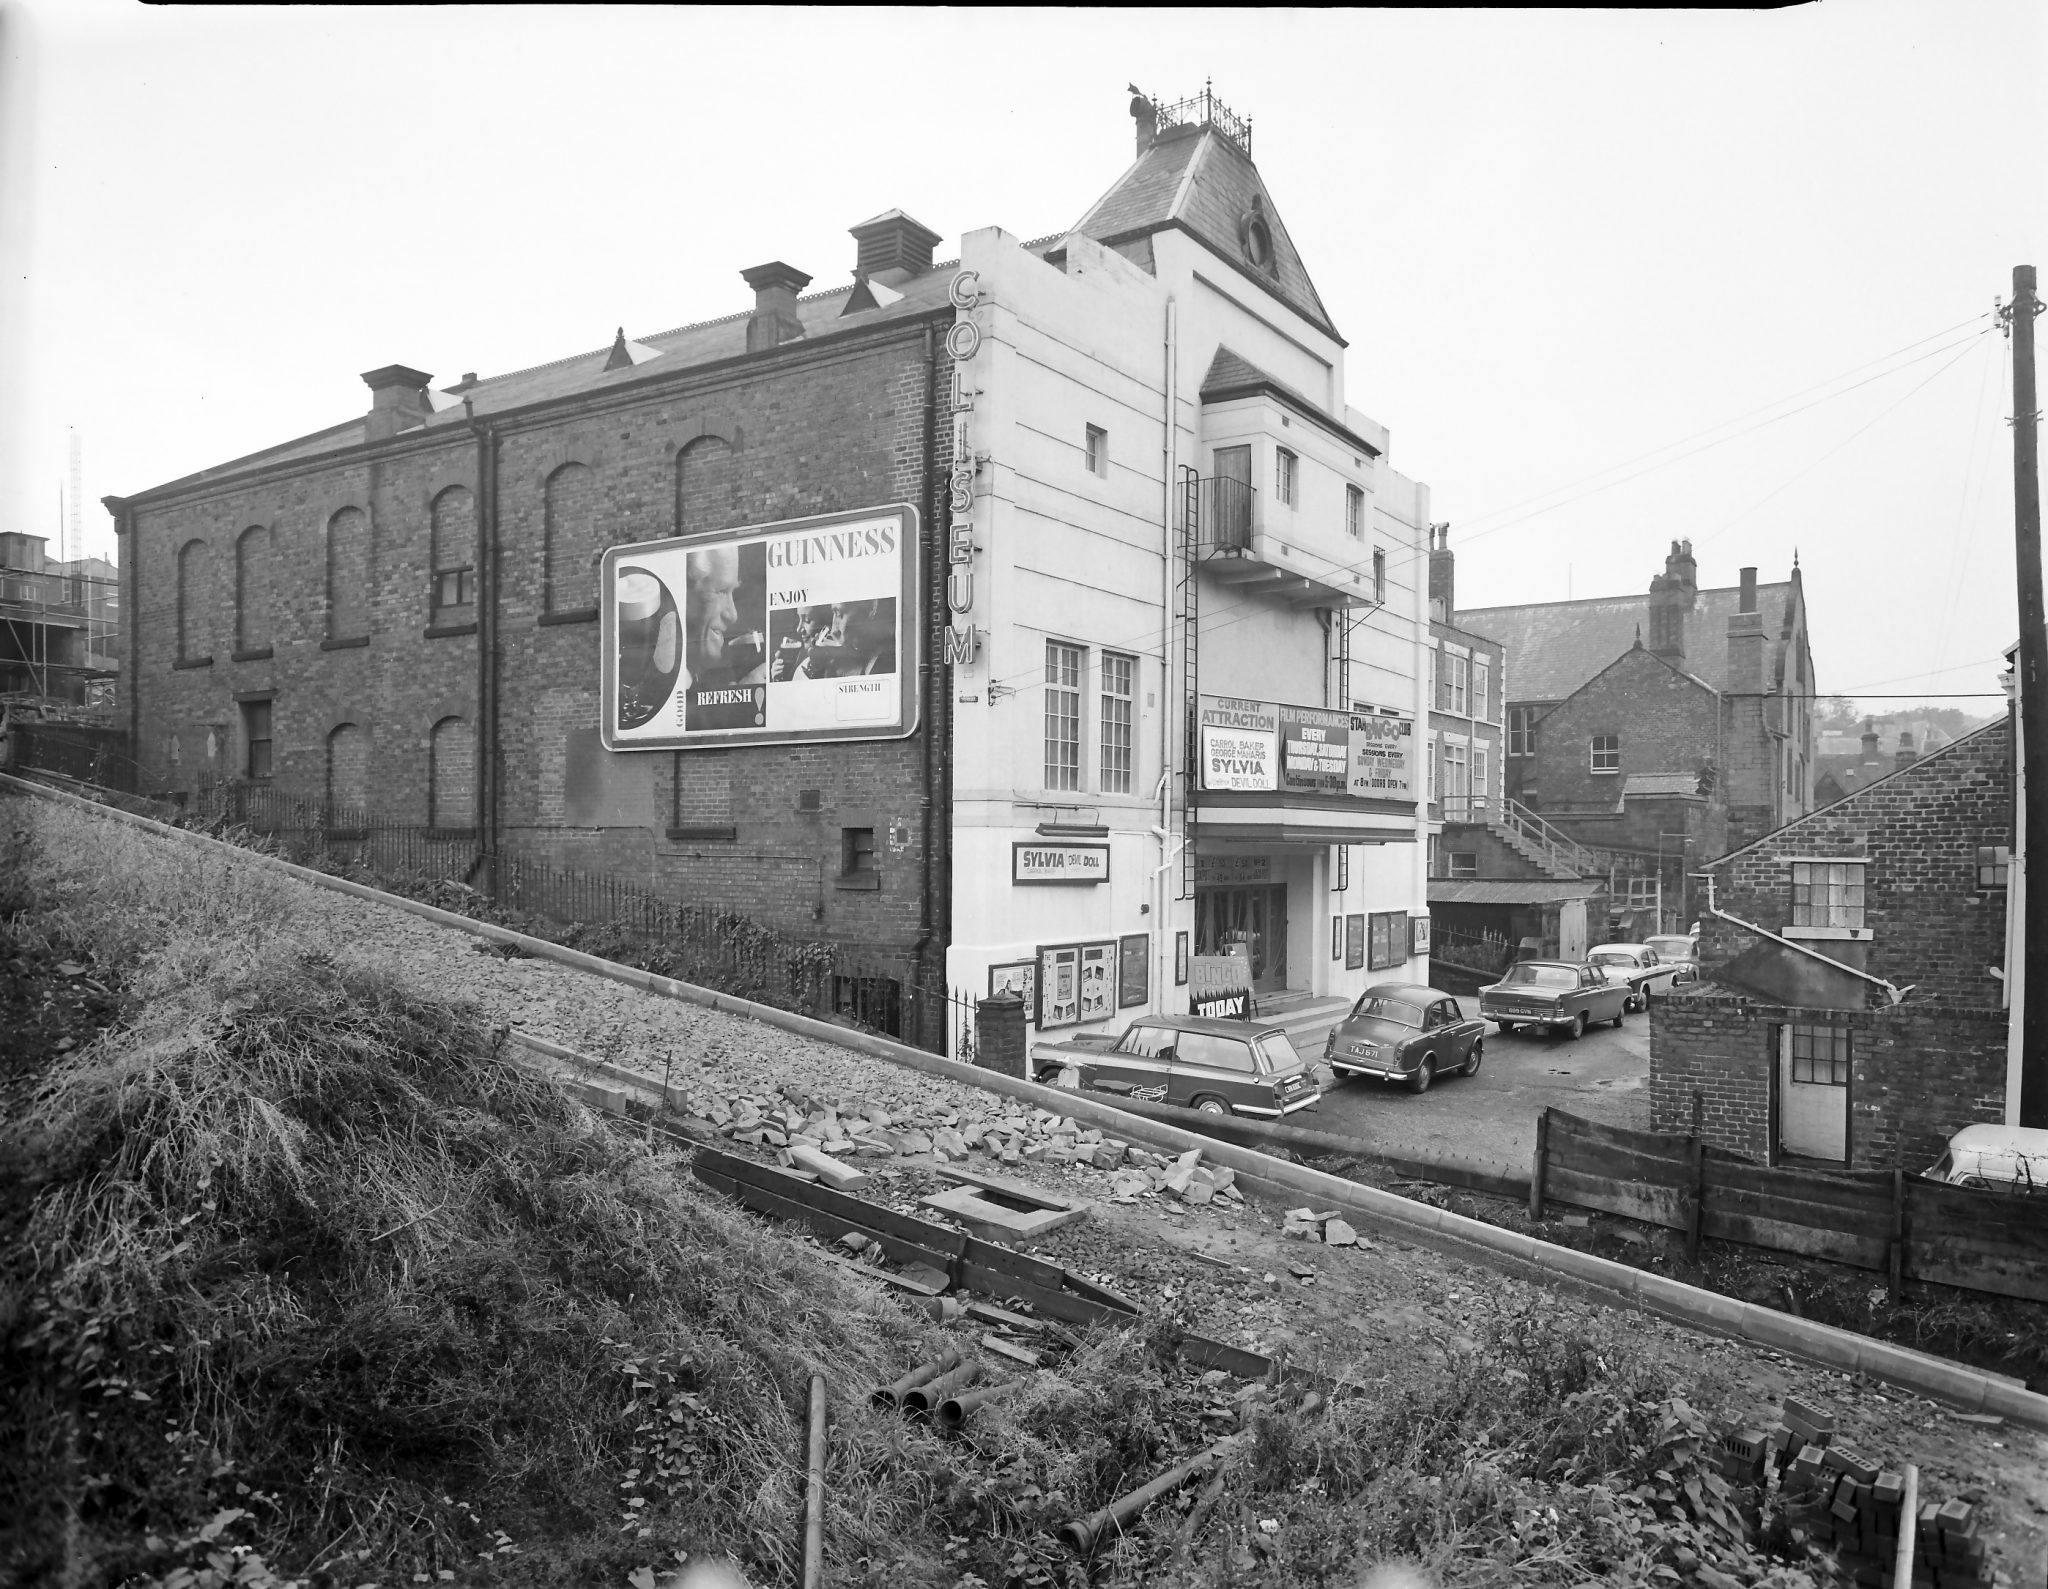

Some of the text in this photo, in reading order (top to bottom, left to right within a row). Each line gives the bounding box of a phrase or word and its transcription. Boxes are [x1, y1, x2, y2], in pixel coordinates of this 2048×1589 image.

[943, 270, 982, 665] COLISEUM
[767, 526, 895, 569] GUINNESS
[769, 588, 809, 606] ENJOY
[838, 682, 882, 694] STRENGTH
[675, 690, 684, 728] GOOD
[1217, 698, 1262, 713] CURRENT
[1201, 709, 1275, 729] ATTRACTION
[1280, 707, 1349, 729] FILM PERFORMANCES
[1301, 727, 1326, 742] EVERY
[1365, 717, 1400, 741] BINGO
[1399, 722, 1411, 736] CLUB
[1210, 738, 1265, 750] CARROL BAKER
[1210, 748, 1266, 760] GEORGE MAHARIS
[1211, 757, 1265, 776] SYLVIA
[1319, 758, 1347, 774] TUESDAY
[1231, 777, 1252, 788] DEVIL
[1252, 778, 1272, 789] DOLL
[1023, 850, 1099, 868] SYLVIA DEVIL DOLL
[1194, 962, 1240, 984] BINGO
[1197, 996, 1246, 1018] TODAY
[1350, 1045, 1365, 1055] TAJ
